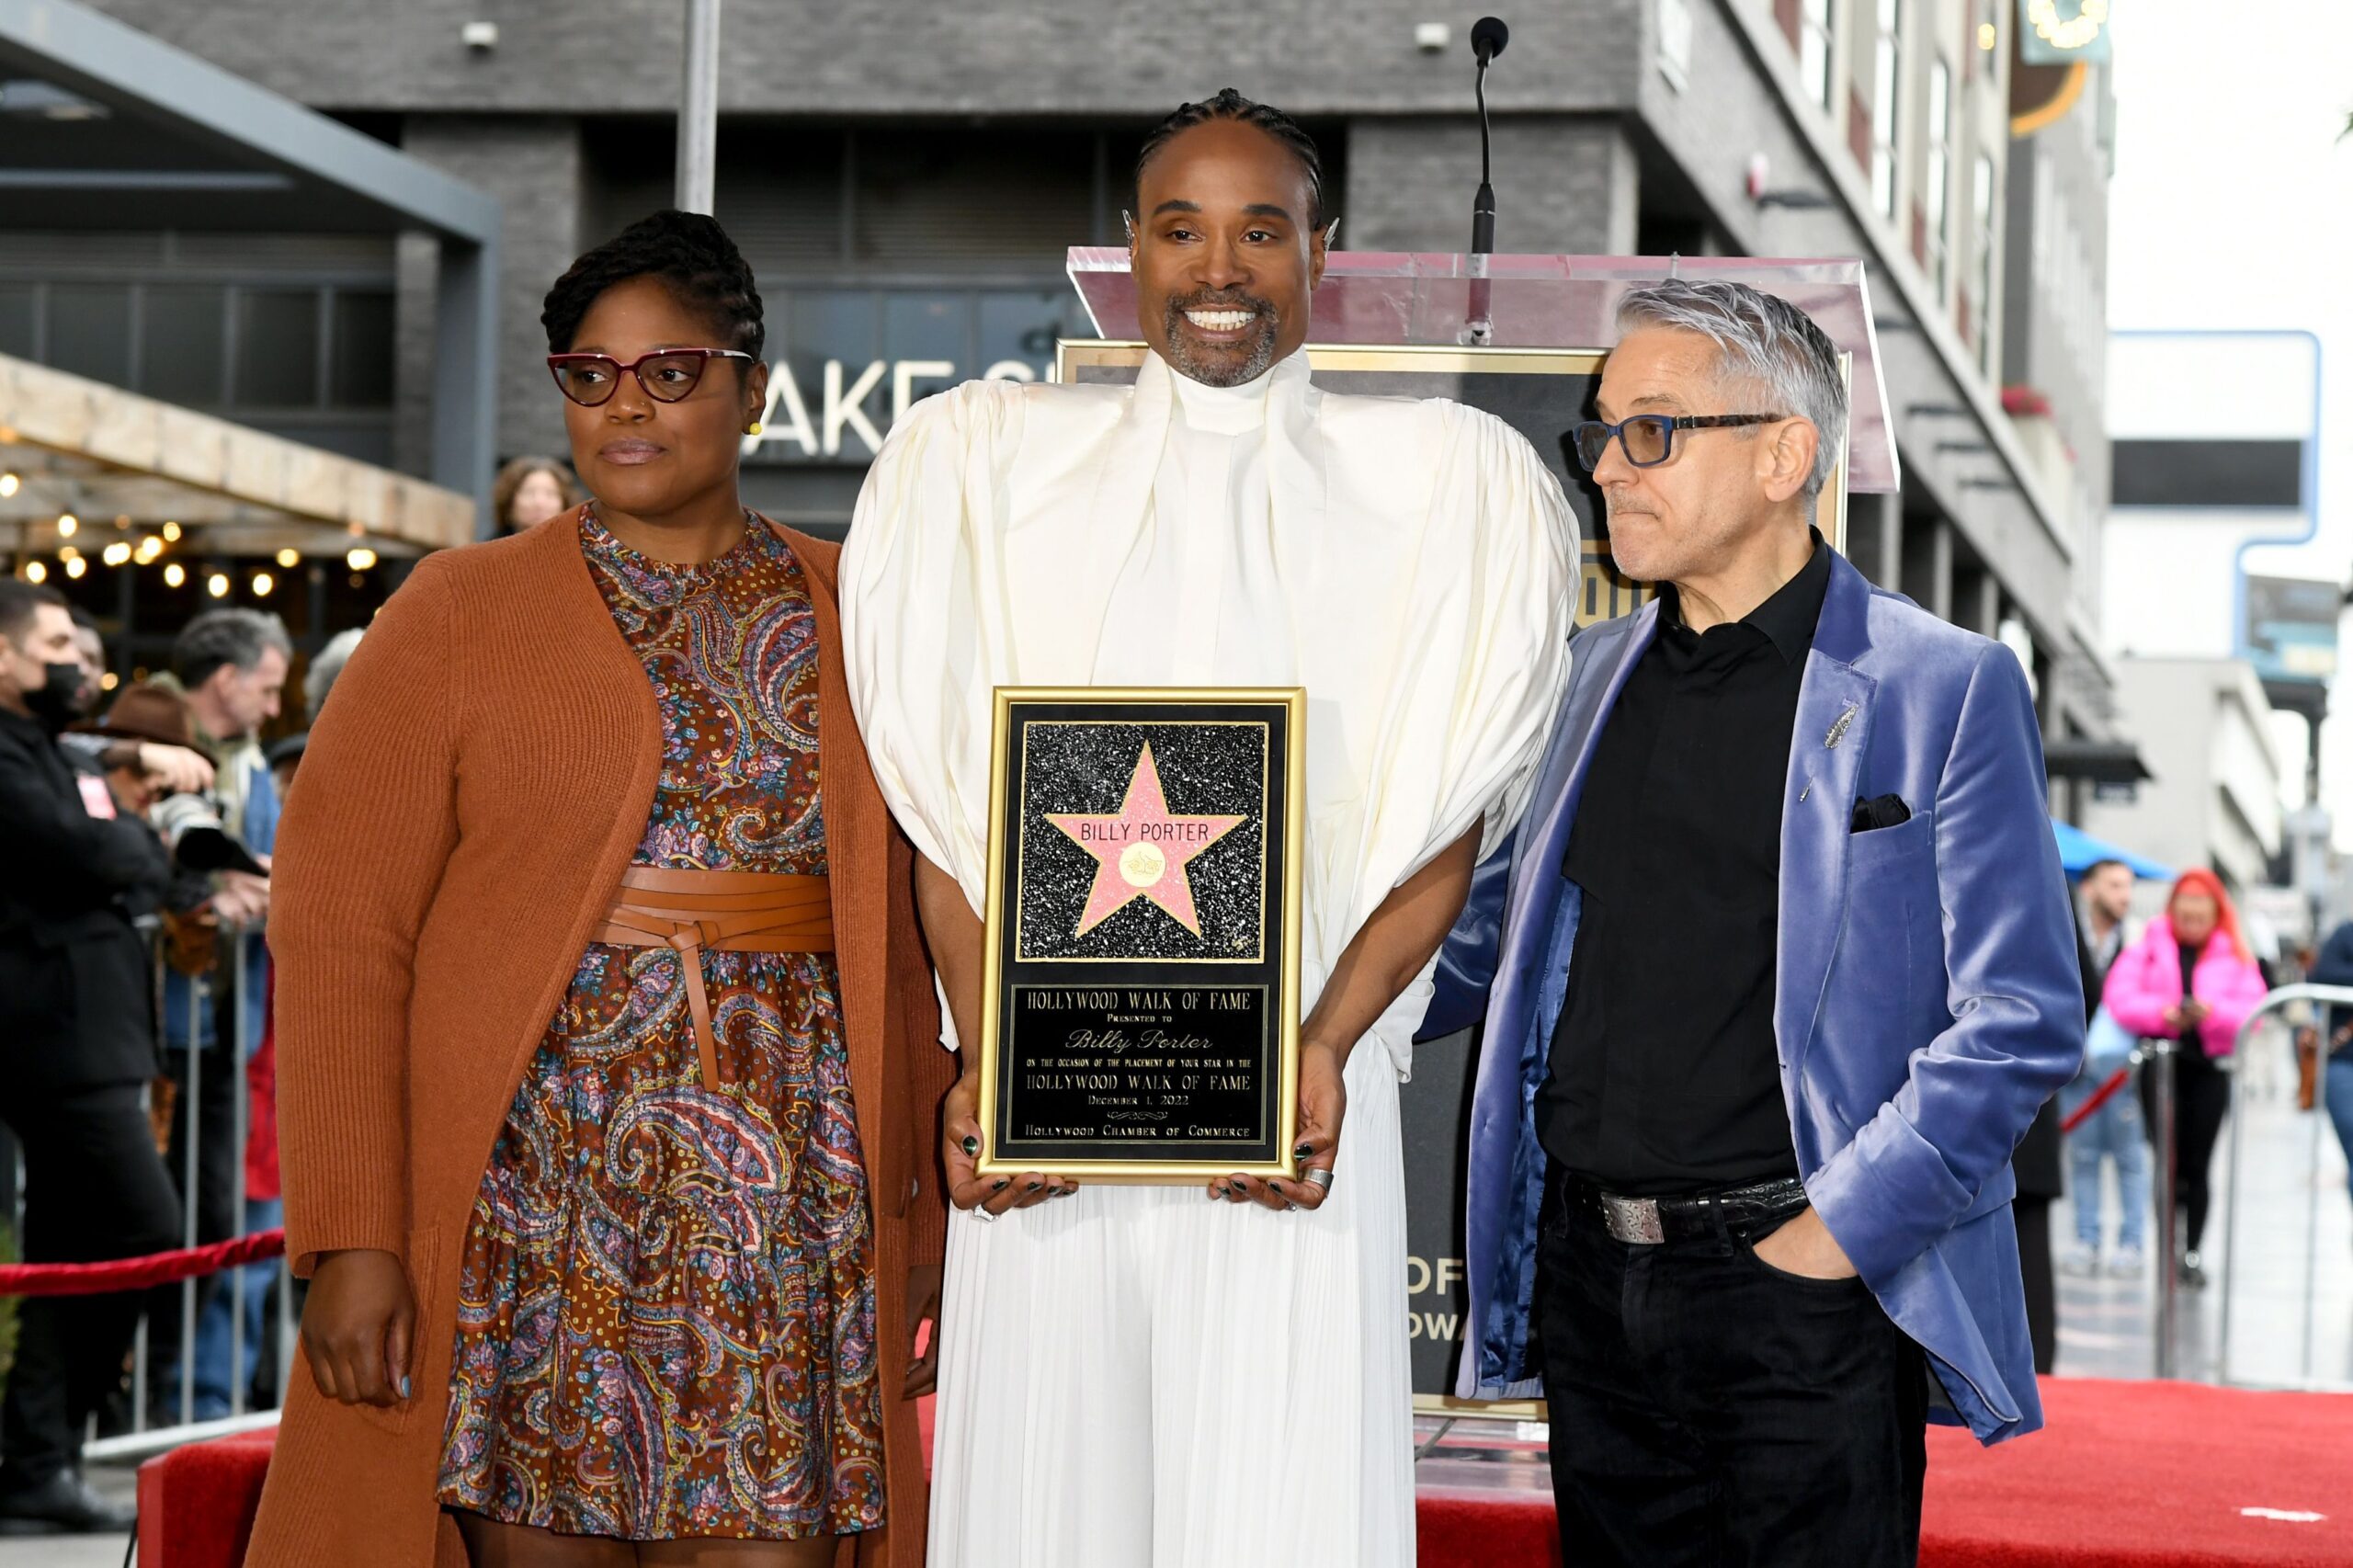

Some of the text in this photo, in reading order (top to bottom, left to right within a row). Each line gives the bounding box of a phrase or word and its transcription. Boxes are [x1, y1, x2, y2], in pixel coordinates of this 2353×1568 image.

[1081, 823, 1209, 841] BILLY PORTER
[1028, 992, 1250, 1010] HOLLYWOOD WALK OF FAME
[1065, 1028, 1213, 1054] Billy Porter
[1124, 1059, 1163, 1067] PLACEMENT
[1166, 1059, 1176, 1067] OF
[1181, 1059, 1199, 1067] YOUR
[1203, 1059, 1222, 1067] STAR
[1027, 1074, 1250, 1090] HOLLYWOOD WALK OF FAME
[1160, 1095, 1189, 1106] 2022
[1407, 1256, 1463, 1295] OF
